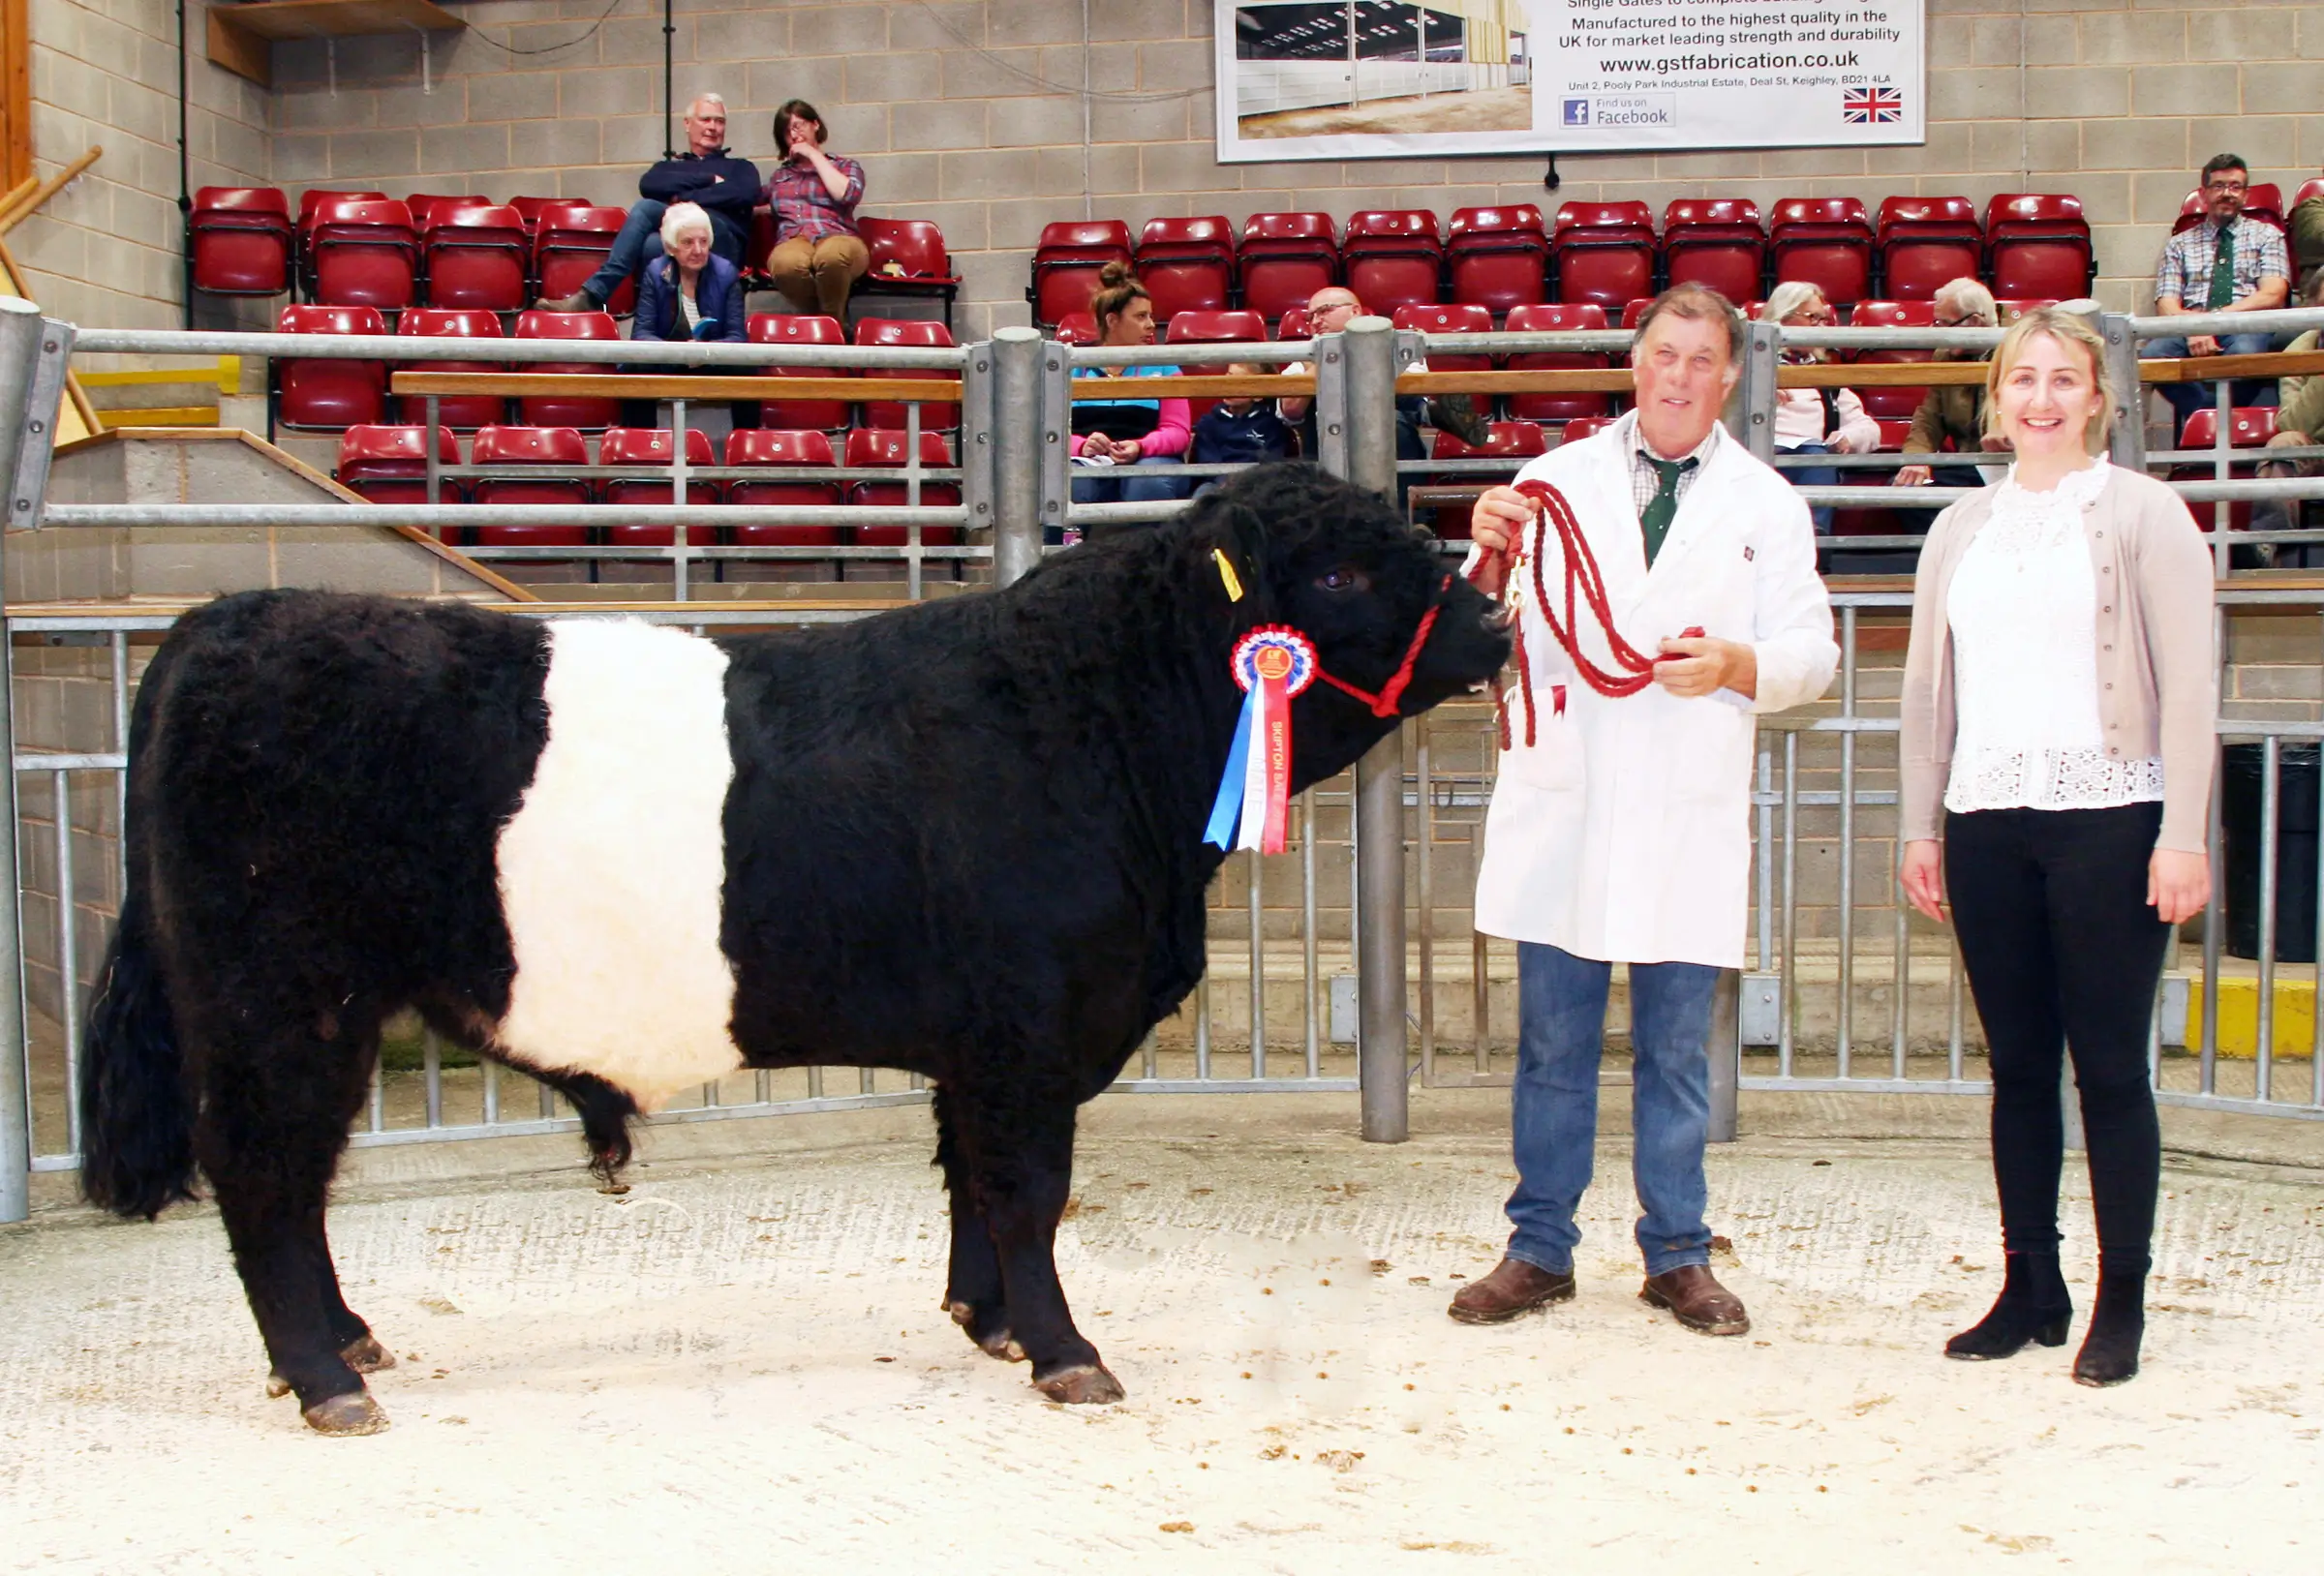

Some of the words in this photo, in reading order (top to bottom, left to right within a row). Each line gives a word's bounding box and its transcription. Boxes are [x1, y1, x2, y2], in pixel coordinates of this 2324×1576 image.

[1568, 0, 1613, 10] Single
[1572, 15, 1677, 29] Manufactured
[1682, 15, 1697, 27] to
[1701, 14, 1726, 26] the
[1730, 12, 1787, 27] highest
[1790, 10, 1842, 25] quality
[1846, 10, 1859, 22] in
[1863, 9, 1887, 22] the
[1559, 35, 1581, 47] UK
[1586, 35, 1607, 46] for
[1612, 33, 1666, 46] market
[1670, 32, 1725, 46] leading
[1729, 30, 1792, 45] strength
[1797, 29, 1825, 42] and
[1830, 27, 1901, 43] durability
[1600, 50, 1859, 74] www.gstfabrication.co.uk
[1569, 81, 1589, 91] Unit
[1636, 79, 1658, 89] Park
[1662, 78, 1708, 88] Industrial
[1712, 77, 1747, 88] Estate,
[1750, 77, 1773, 86] Deal
[1842, 75, 1868, 84] BD21
[1872, 75, 1891, 83] 4LA
[1596, 98, 1618, 107] Find
[1620, 99, 1632, 107] us
[1635, 99, 1647, 107] on
[1598, 108, 1668, 125] Facebook
[1271, 721, 1283, 771] SKIPTON
